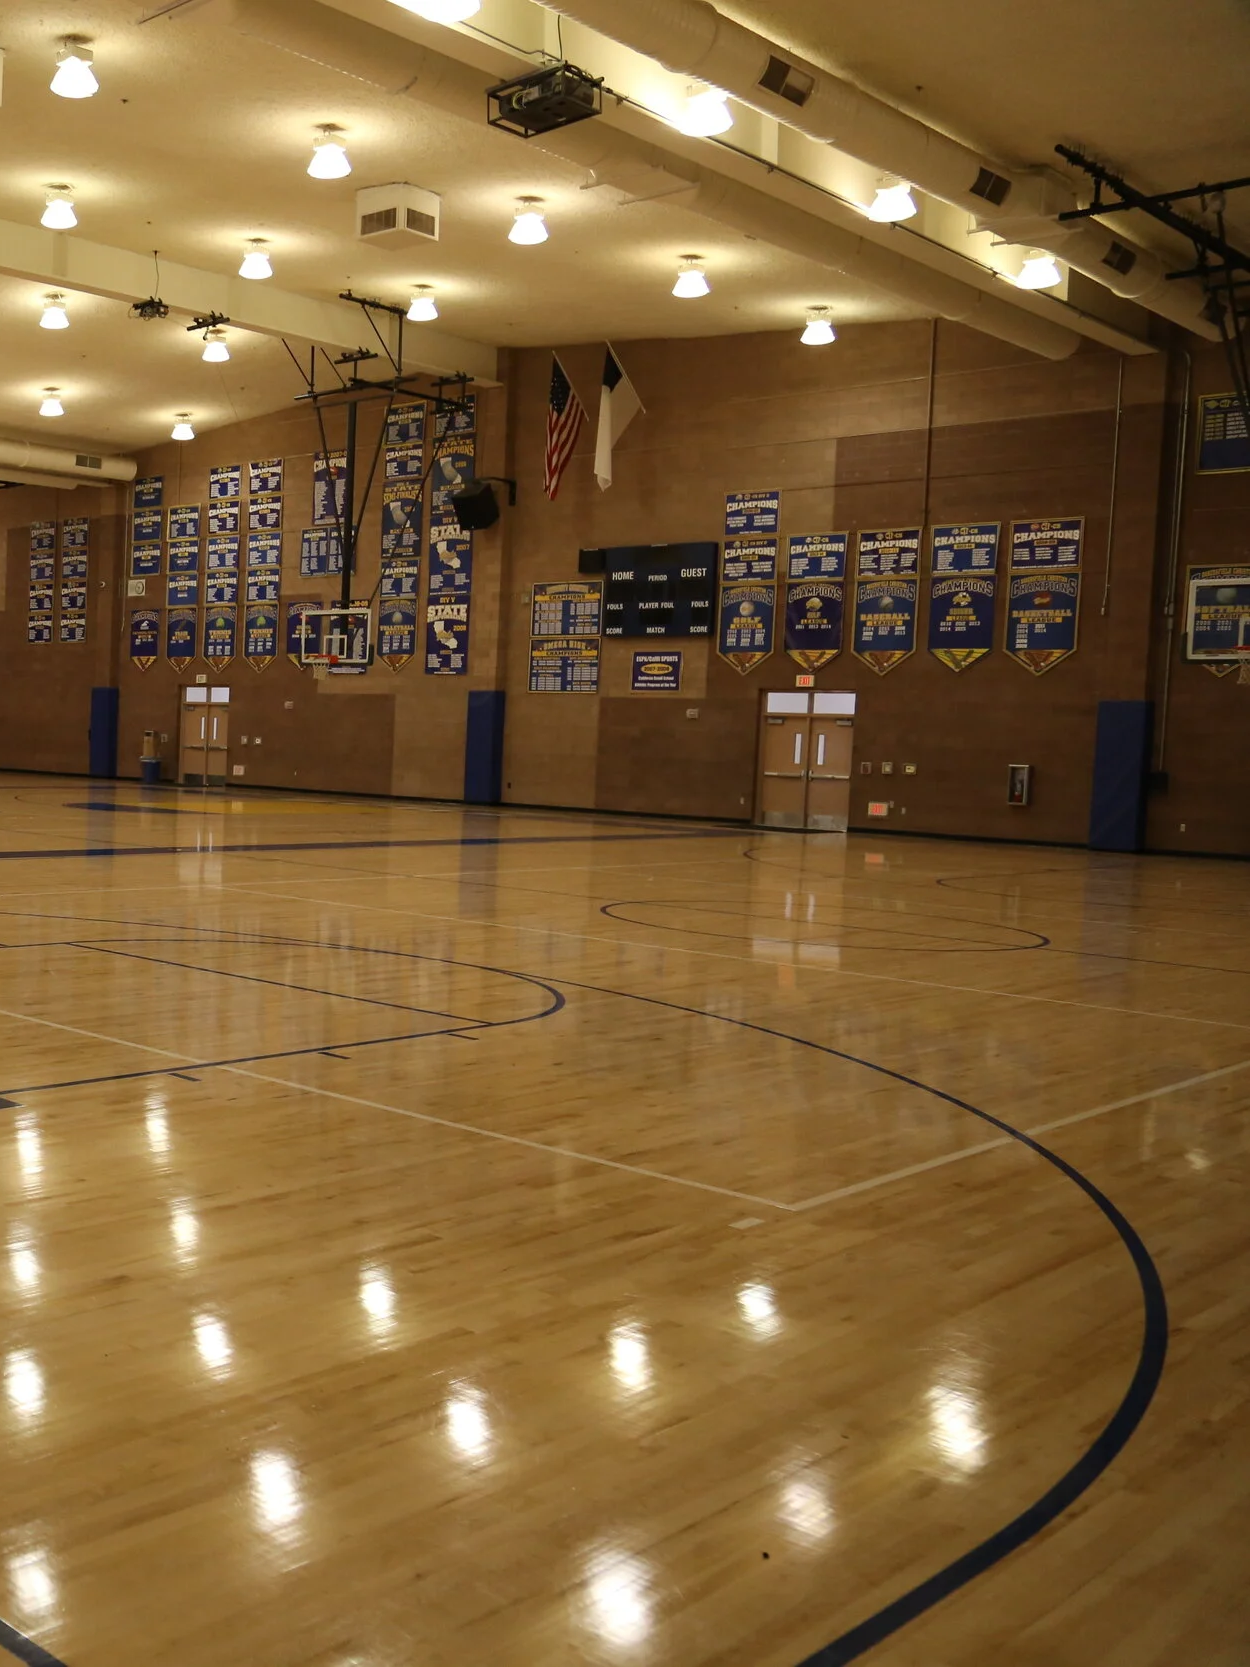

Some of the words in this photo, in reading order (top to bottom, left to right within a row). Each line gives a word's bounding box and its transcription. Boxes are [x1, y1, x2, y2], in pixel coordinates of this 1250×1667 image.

[388, 411, 423, 423] CHAMPIONS
[386, 449, 423, 460] CHAMPIONS
[314, 457, 347, 472] CHAMPION
[727, 500, 778, 512] CHAMPIONS
[430, 524, 461, 540] STAT
[1014, 529, 1080, 544] CHAMPIONS
[860, 539, 918, 552] CHAMPIONS
[934, 534, 996, 547] CHAMPIONS
[725, 546, 776, 559] CHAMPIONS
[791, 543, 844, 555] CHAMPIONS
[612, 571, 634, 580] HOME
[648, 574, 667, 582] PERIOD
[681, 568, 707, 578] GUEST
[789, 585, 842, 603] CHAMPIONS
[858, 584, 916, 603] CHAMPIONS
[933, 580, 994, 599] CHAMPIONS
[1011, 578, 1077, 599] CHAMPIONS
[427, 604, 467, 619] STATE
[860, 612, 910, 621] BASEBALL
[1012, 609, 1072, 618] BASKETBALL
[606, 627, 623, 635] SCORE
